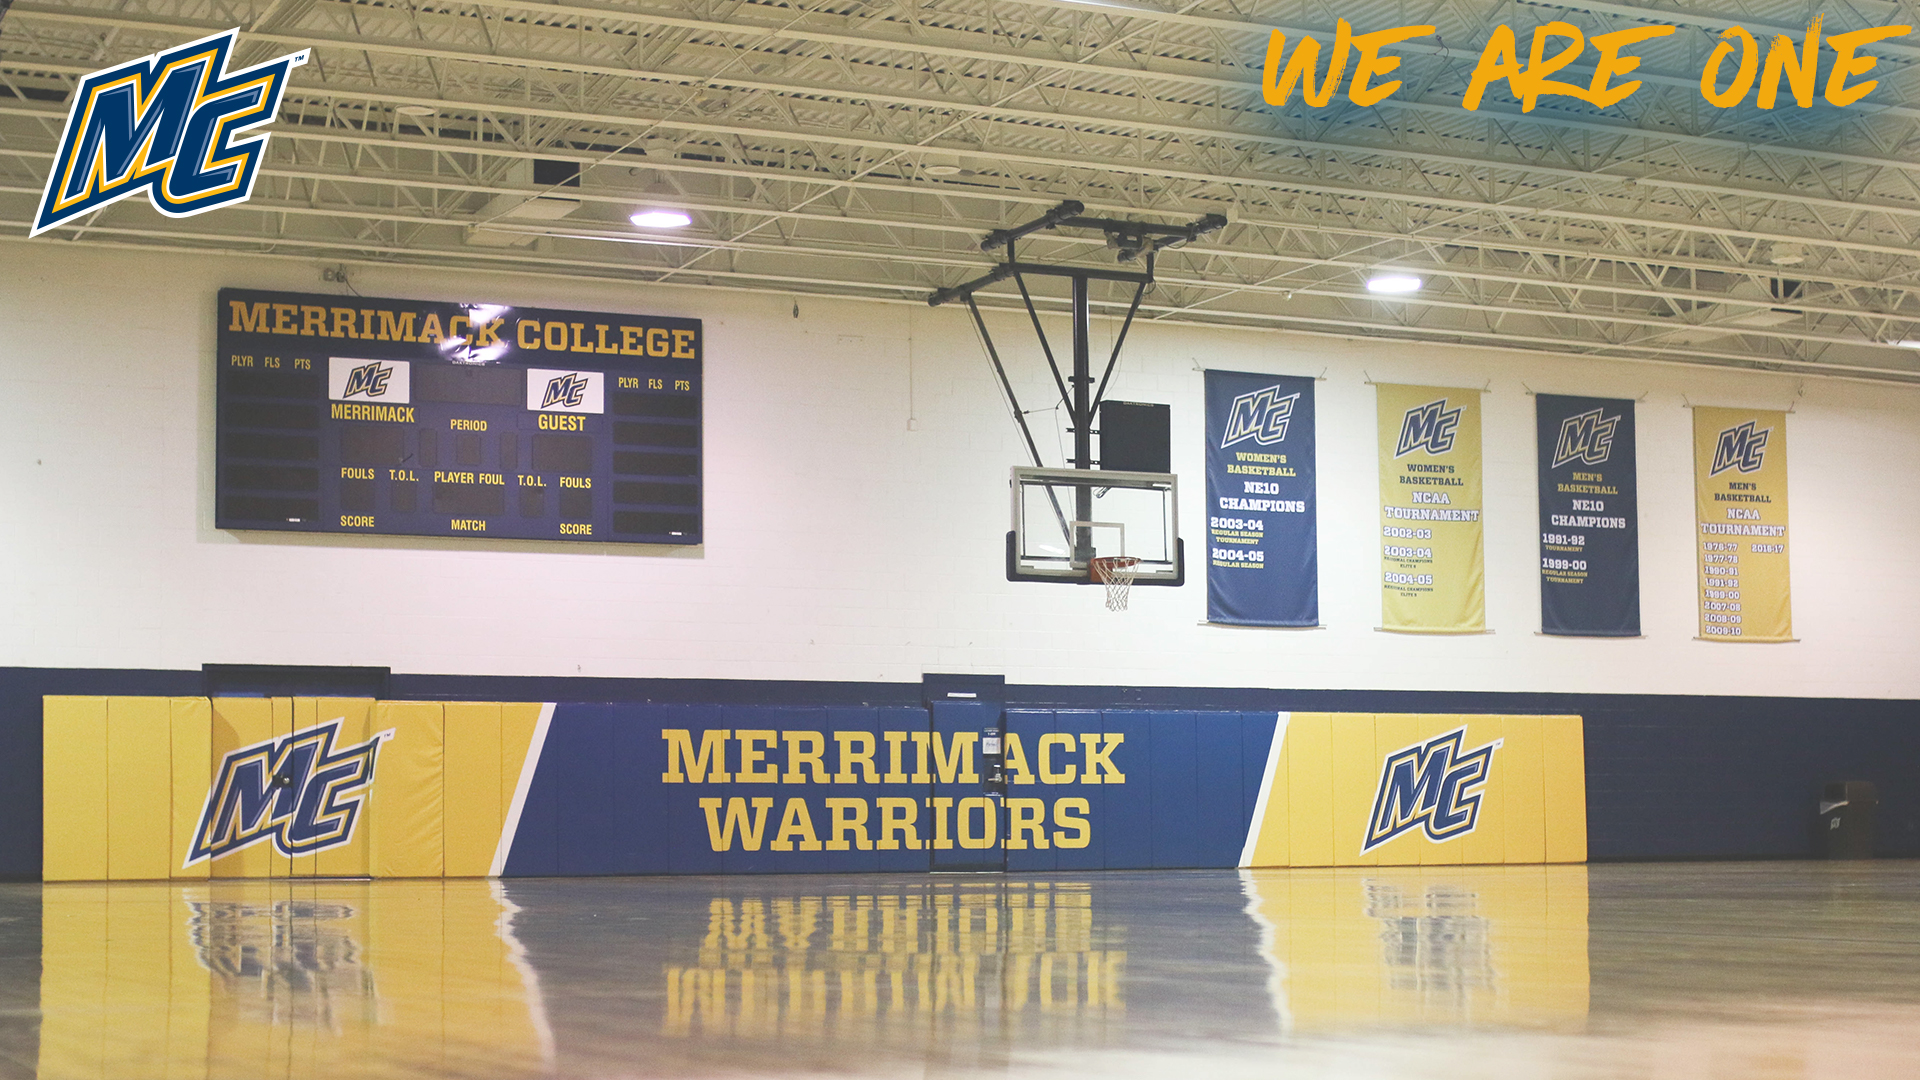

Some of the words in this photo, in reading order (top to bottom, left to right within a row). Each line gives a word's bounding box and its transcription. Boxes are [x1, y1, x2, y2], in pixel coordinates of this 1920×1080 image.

[229, 301, 505, 347] MERRIMACK
[517, 319, 695, 360] COLLEGE
[231, 355, 254, 367] PLYR
[264, 356, 281, 369] FLS
[294, 358, 311, 370] PTS
[343, 361, 394, 399] MC
[618, 377, 639, 389] PLYR
[648, 378, 663, 390] FLS
[675, 380, 690, 391] PTS
[540, 373, 588, 409] MC
[331, 403, 415, 423] MERRIMACK
[1221, 384, 1299, 449] MC
[450, 419, 488, 432] PERIOD
[538, 413, 586, 432] GUEST
[1393, 397, 1464, 460] MC
[1552, 407, 1620, 469] MC
[1708, 419, 1770, 478] MC
[1236, 452, 1287, 464] WOMEN'S
[340, 467, 375, 480] FOULS
[1227, 464, 1296, 477] BASKETBALL
[1407, 463, 1455, 474] WOMEN'S
[389, 470, 419, 482] T.O.L.
[434, 471, 475, 484] PLAYER
[479, 473, 506, 486] FOUL
[518, 475, 547, 487] T.O.L.
[560, 476, 592, 489] FOULS
[1399, 475, 1464, 486] BASKETBALL
[1572, 472, 1603, 482] MEN'S
[1244, 481, 1280, 495] NE10
[1557, 483, 1618, 495] BASKETBALL
[1729, 482, 1757, 491] MEN'S
[1219, 497, 1305, 513] CHAMPIONS
[1412, 491, 1451, 505] NCAA
[1714, 493, 1772, 503] BASKETBALL
[1572, 499, 1604, 512] NE10
[1384, 506, 1480, 522] TOURNAMENT
[1727, 508, 1761, 520] NCAA
[340, 515, 375, 528] SCORE
[451, 519, 486, 532] MATCH
[1211, 516, 1264, 531] 2003-04
[1551, 514, 1626, 529] CHAMPIONS
[560, 523, 593, 535] SCORE
[1383, 526, 1432, 539] 2002-03
[1700, 522, 1786, 537] TOURNAMENT
[1542, 533, 1585, 546] 1991-92
[1212, 547, 1264, 562] 2004-05
[1384, 545, 1433, 559] 2003-04
[1542, 557, 1587, 571] 1999-00
[1384, 571, 1433, 585] 2004-05
[661, 728, 1126, 785] MERRIMACK
[182, 717, 383, 869] MC
[1359, 724, 1496, 857] MC
[698, 796, 1092, 852] WARRIORS
